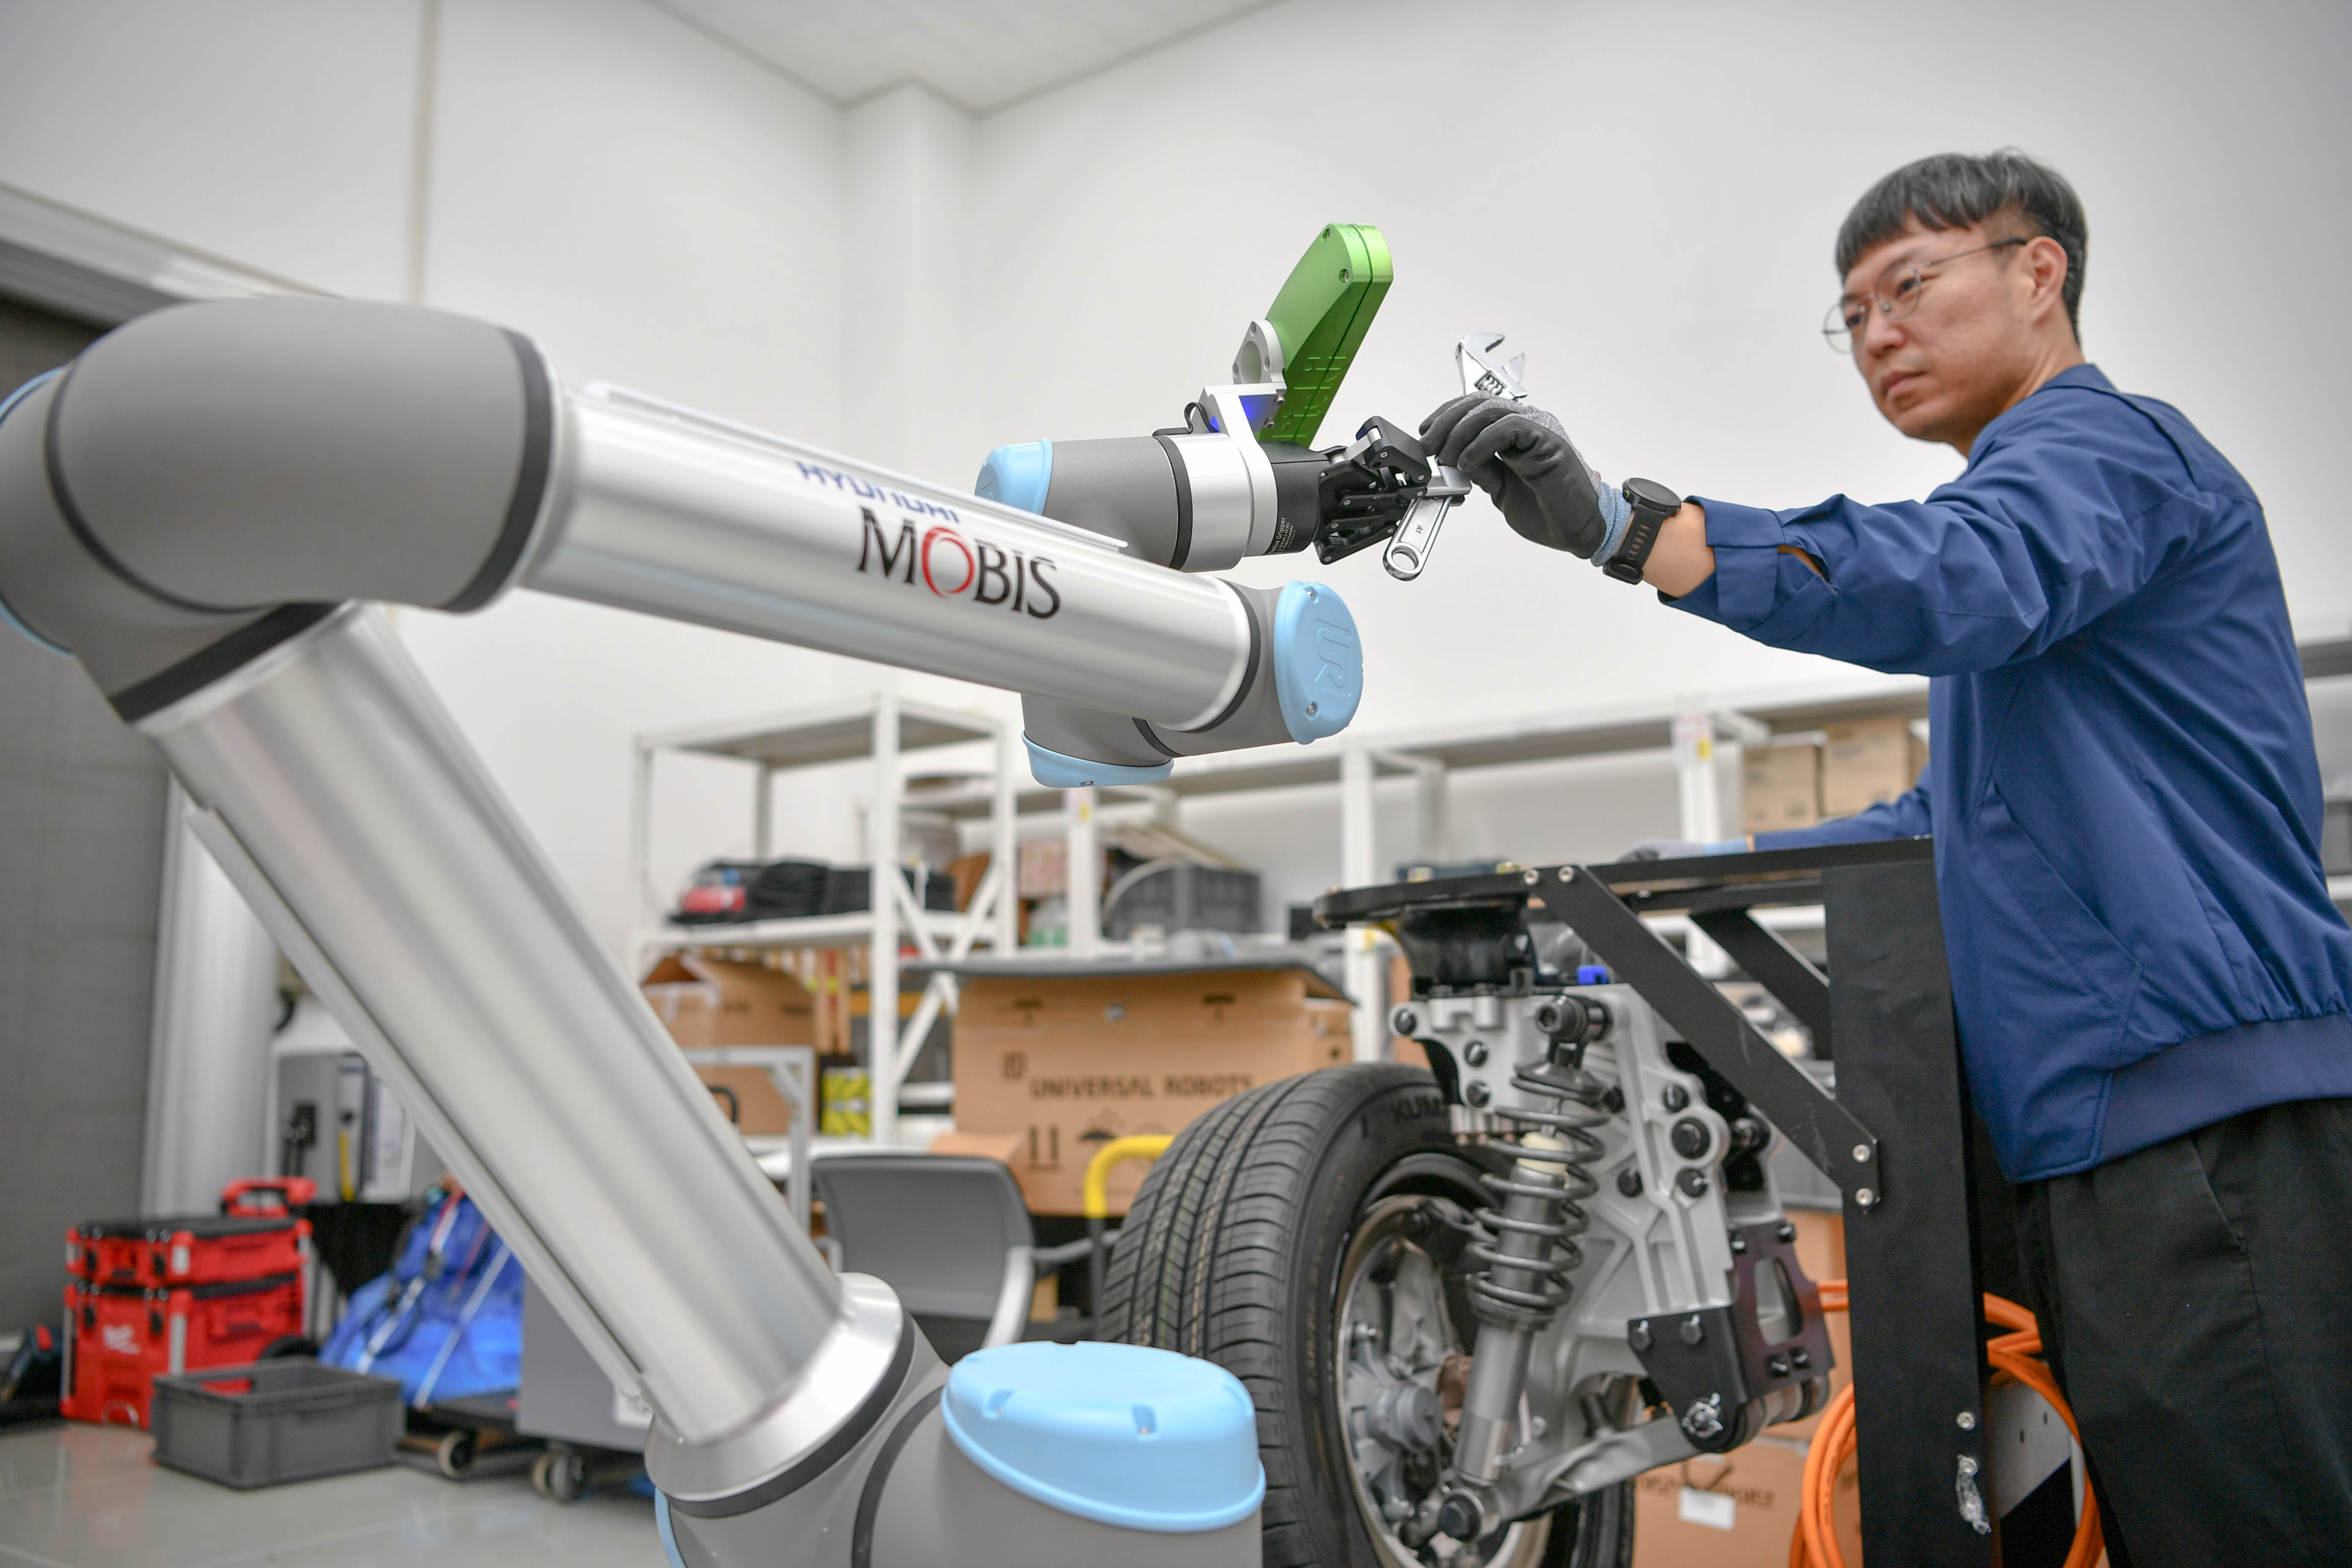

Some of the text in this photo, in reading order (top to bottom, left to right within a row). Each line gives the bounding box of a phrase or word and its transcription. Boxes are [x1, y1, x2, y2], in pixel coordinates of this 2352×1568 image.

[1276, 517, 1286, 540] Gripper
[857, 505, 1061, 620] MOBIS
[1030, 1074, 1253, 1097] UNIVERSAL ROBOTS
